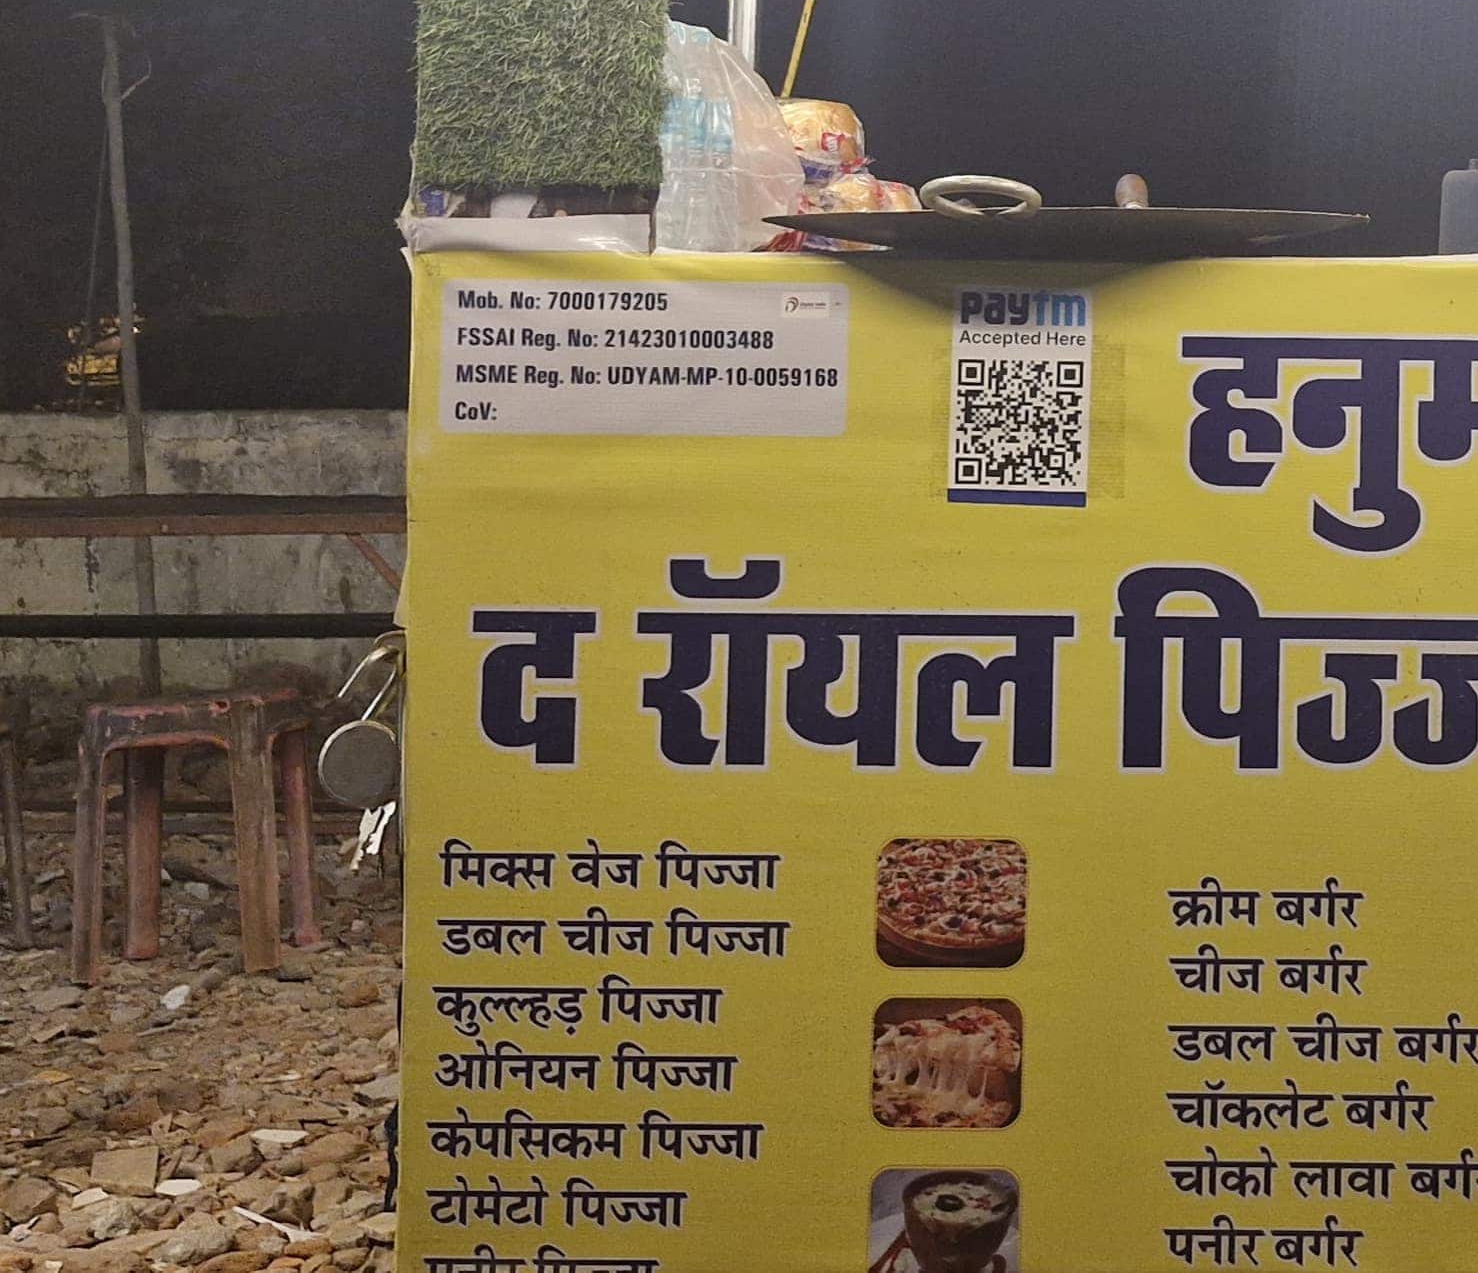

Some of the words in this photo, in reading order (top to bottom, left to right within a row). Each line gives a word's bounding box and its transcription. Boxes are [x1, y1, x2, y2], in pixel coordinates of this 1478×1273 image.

[458, 290, 503, 309] Mob.
[510, 291, 541, 310] No:
[548, 291, 668, 311] 7000179205
[958, 287, 1088, 327] paytm
[457, 327, 515, 347] FSSAI
[521, 328, 561, 352] Reg.
[567, 328, 598, 348] No:
[604, 329, 774, 350] 21423010003488
[959, 329, 1042, 348] Accepted
[1046, 330, 1086, 347] Here
[456, 364, 518, 384] MSME
[524, 365, 564, 389] Reg.
[570, 365, 601, 385] No:
[607, 366, 838, 387] UDYAM-MP-10-0059168
[455, 401, 497, 421] CoV:
[472, 610, 597, 764] द
[636, 558, 1075, 768] रॉयल
[438, 838, 556, 890] मिक्स
[566, 838, 644, 889] वेज
[654, 840, 781, 890] पिज्जा
[1167, 876, 1261, 927] क्रीम
[1271, 877, 1364, 928] बर्गर
[436, 919, 547, 956] डबल
[557, 906, 654, 956] चीज
[664, 907, 791, 957] पिज्जा
[1169, 943, 1265, 994] चीज
[1275, 944, 1369, 995] बर्गर
[596, 973, 724, 1024] पिज्जा
[1167, 1025, 1277, 1062] डबल
[1286, 1012, 1383, 1062] चीज
[434, 1039, 601, 1091] ओनियन
[611, 1041, 739, 1092] पिज्जा
[1165, 1078, 1335, 1130] चॉकलेट
[1341, 1079, 1435, 1131] बर्गर
[426, 1106, 627, 1160] केपसिकम
[637, 1109, 765, 1160] पिज्जा
[1164, 1145, 1278, 1198] चोको
[1288, 1161, 1397, 1198] लावा
[425, 1175, 550, 1226] टोमेटो
[560, 1177, 688, 1227] पिज्जा
[1163, 1214, 1266, 1266] पनीर
[1270, 1214, 1365, 1267] बर्गर
